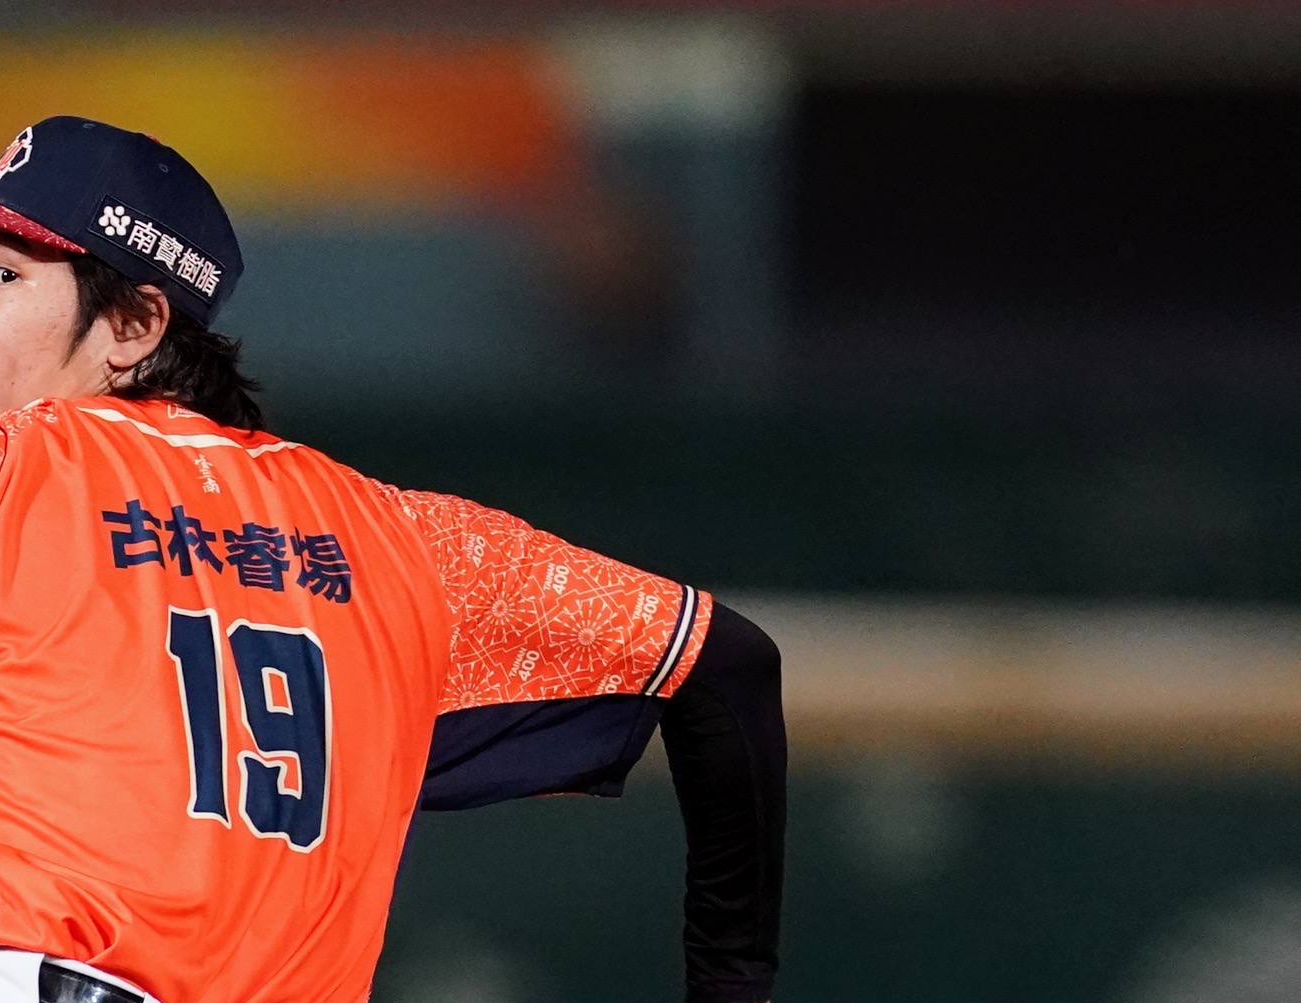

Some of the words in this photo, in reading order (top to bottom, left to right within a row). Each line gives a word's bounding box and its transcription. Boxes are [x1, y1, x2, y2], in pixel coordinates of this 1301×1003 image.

[127, 219, 222, 297] 南寶樹脂
[101, 499, 352, 604] 古林睿煬
[472, 535, 486, 568] 400
[543, 562, 555, 591] TAINAN
[552, 564, 570, 595] 400
[632, 591, 646, 621] TAINAN
[641, 594, 659, 625] 400
[509, 647, 527, 678] TAINAN
[518, 650, 540, 682] 400
[605, 674, 623, 694] 00
[165, 604, 333, 854] 19
